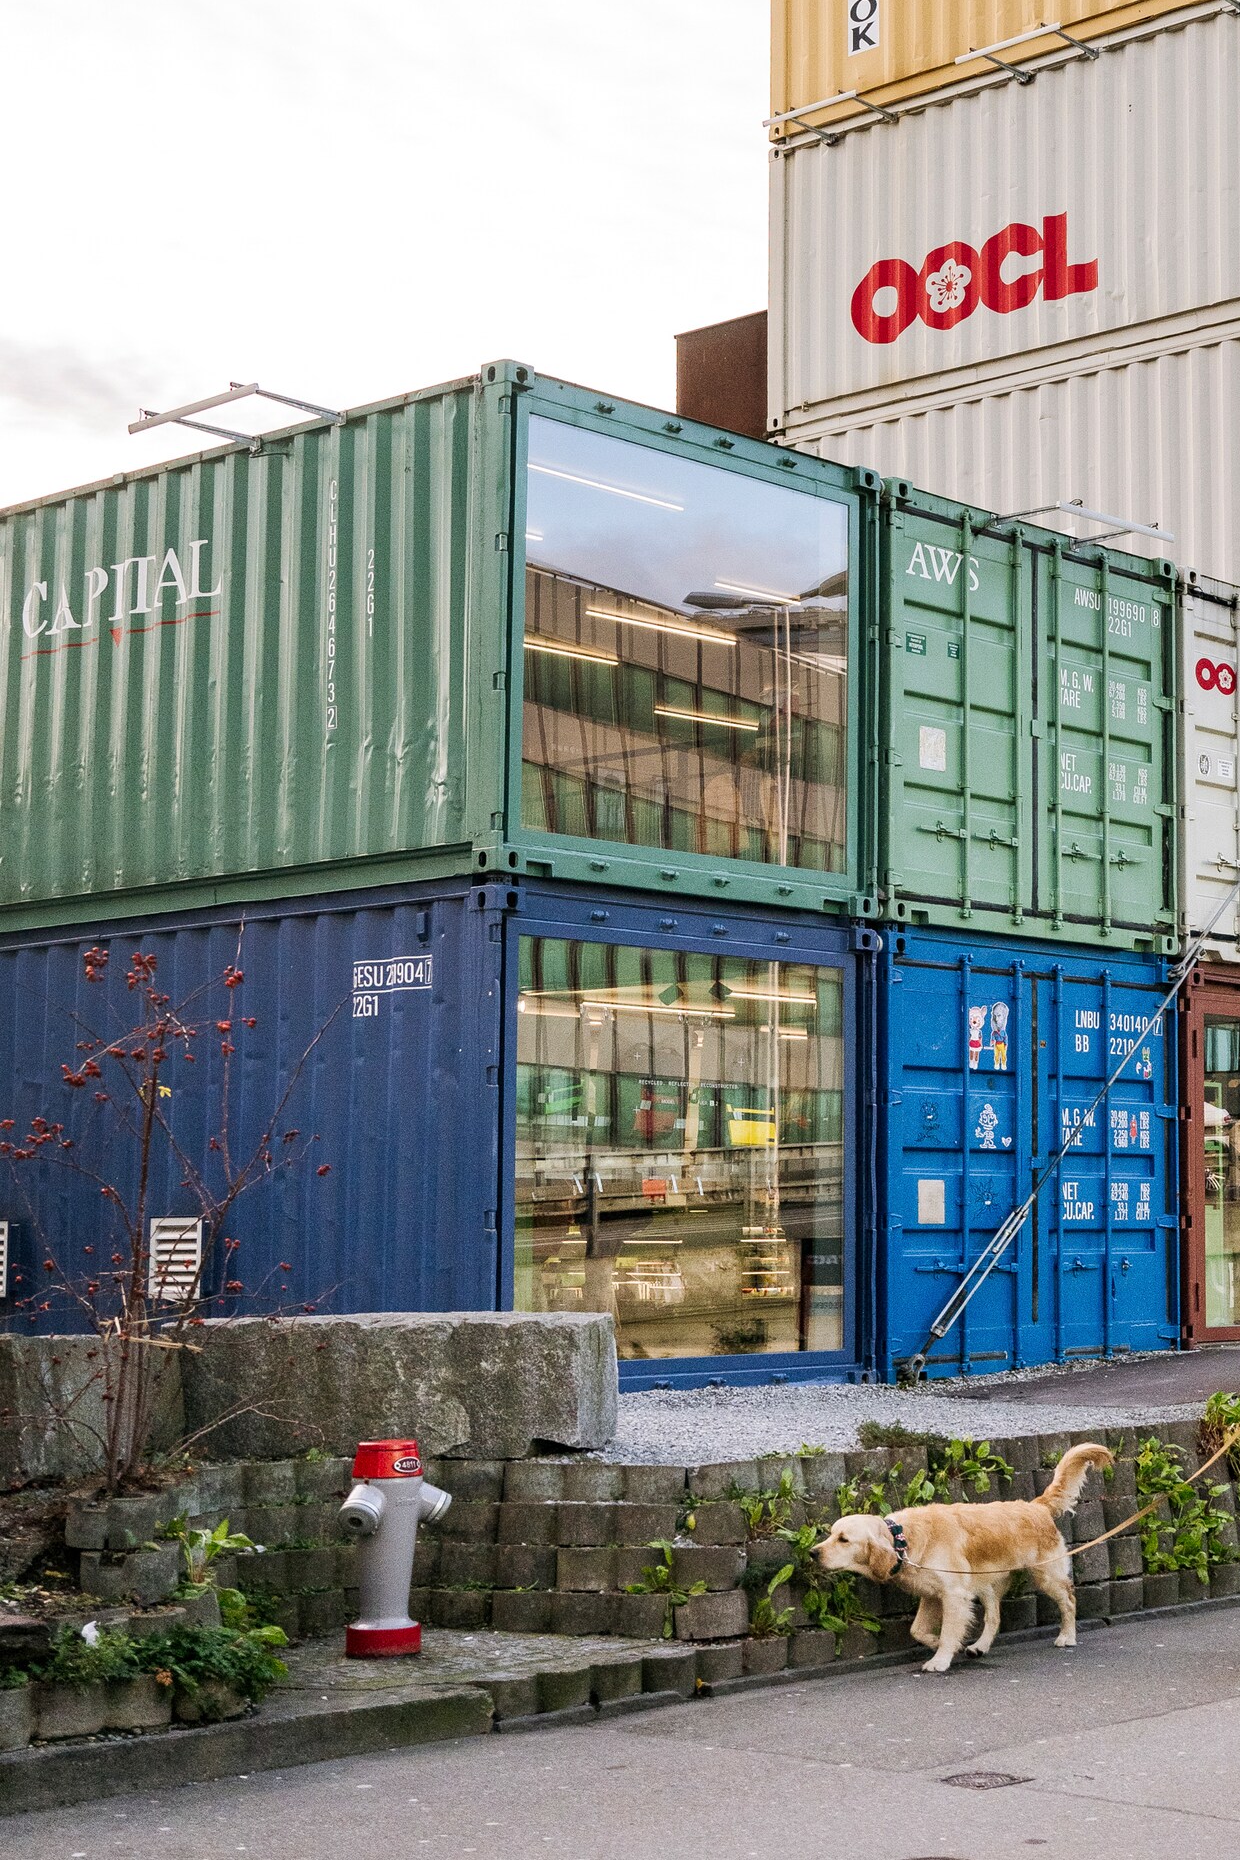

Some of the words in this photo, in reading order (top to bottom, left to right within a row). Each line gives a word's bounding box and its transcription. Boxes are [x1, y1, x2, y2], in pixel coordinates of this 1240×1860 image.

[850, 211, 1098, 345] OOCL
[906, 542, 980, 591] AWS
[22, 540, 222, 639] CAPITAL
[366, 549, 375, 637] 22G1
[1074, 588, 1100, 610] AWSU
[1108, 598, 1145, 623] 199690
[1153, 610, 1160, 626] 8
[1108, 616, 1132, 637] 22G1
[1060, 688, 1081, 708] TARE
[1060, 753, 1077, 771] NET
[1075, 1010, 1100, 1029] LNBU
[1110, 1013, 1148, 1032] 340140
[1075, 1034, 1090, 1052] BB
[1110, 1037, 1134, 1055] 2210
[1062, 1182, 1079, 1200] NET
